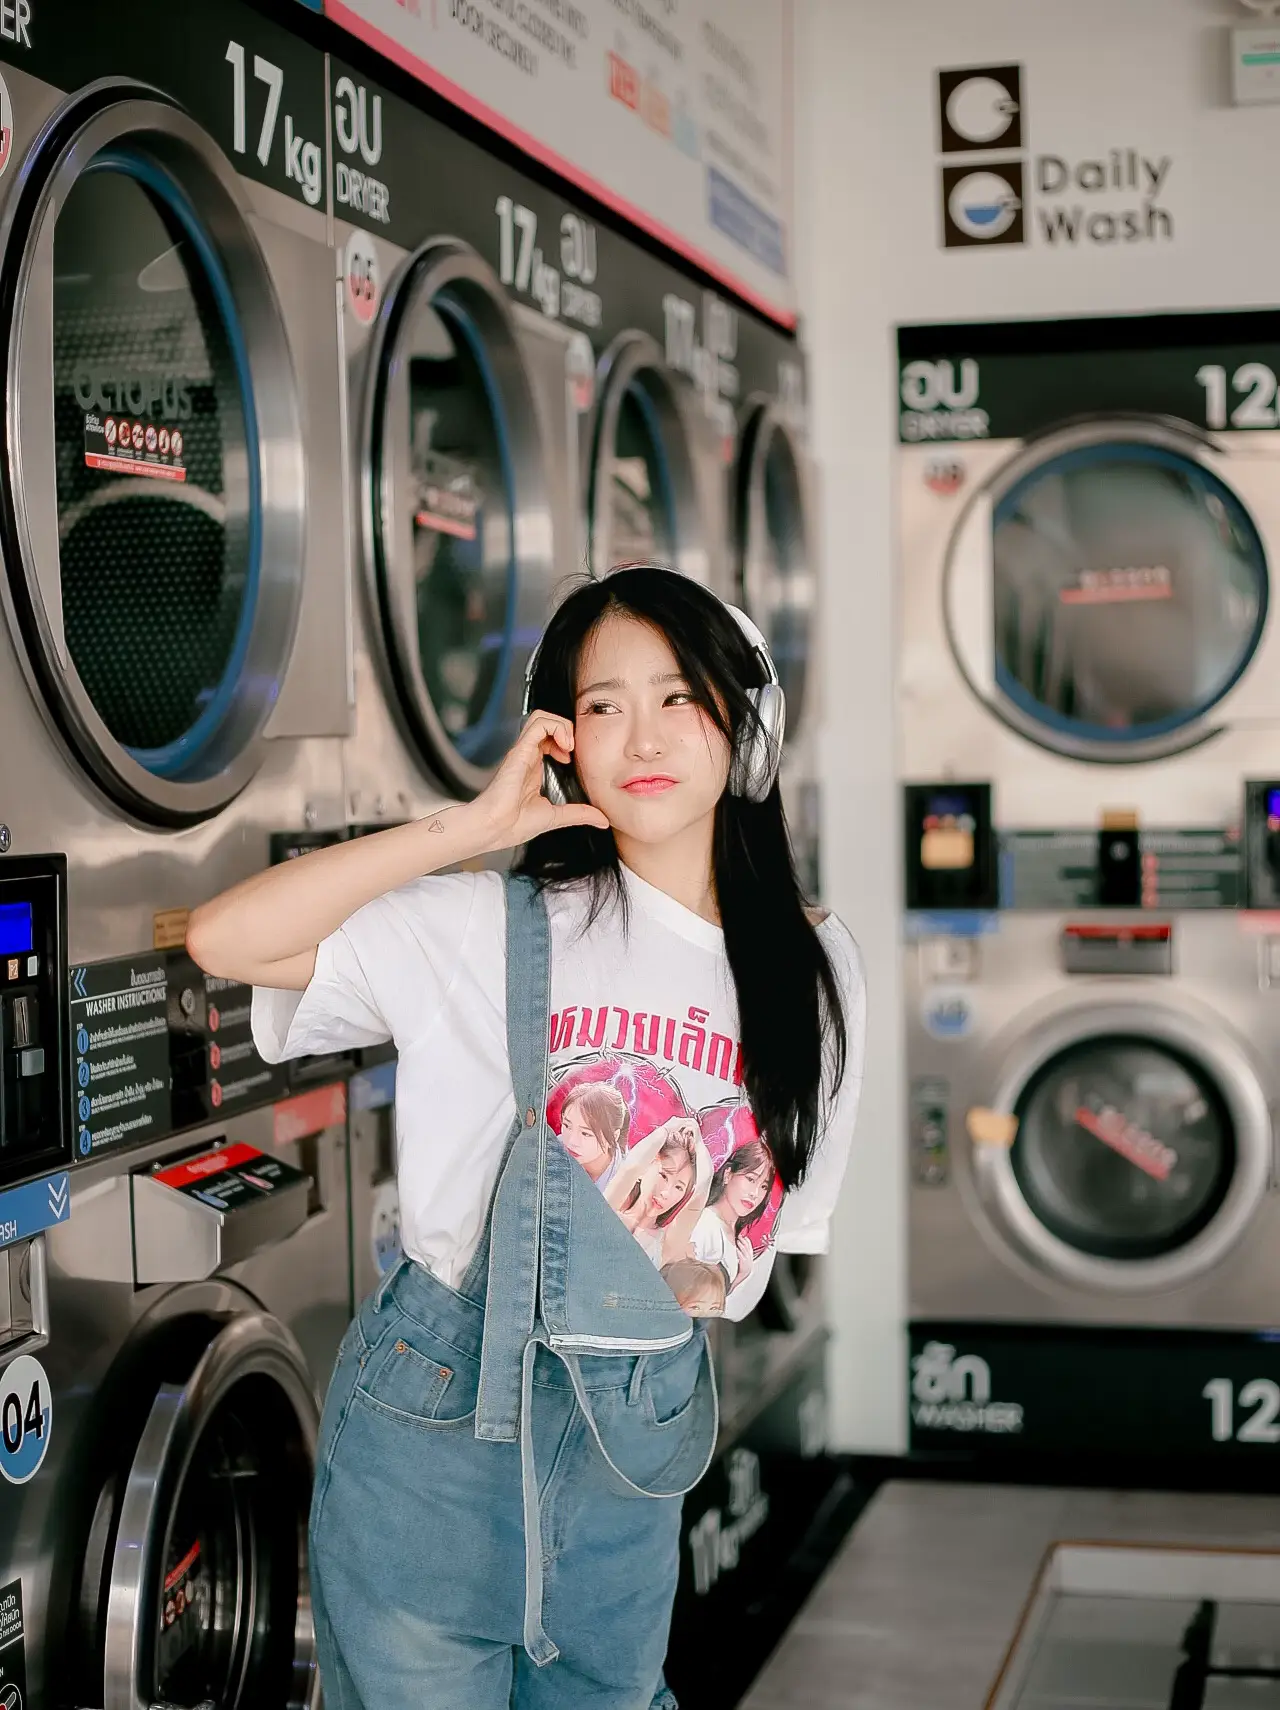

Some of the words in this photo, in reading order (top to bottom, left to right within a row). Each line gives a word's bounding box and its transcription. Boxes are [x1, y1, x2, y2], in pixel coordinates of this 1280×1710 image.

[336, 162, 390, 224] DRYER
[1036, 147, 1172, 201] Daily
[1037, 202, 1174, 243] Wash
[86, 996, 117, 1017] WASHER
[116, 986, 167, 1010] INSTRUCTIONS
[2, 1379, 44, 1455] 04
